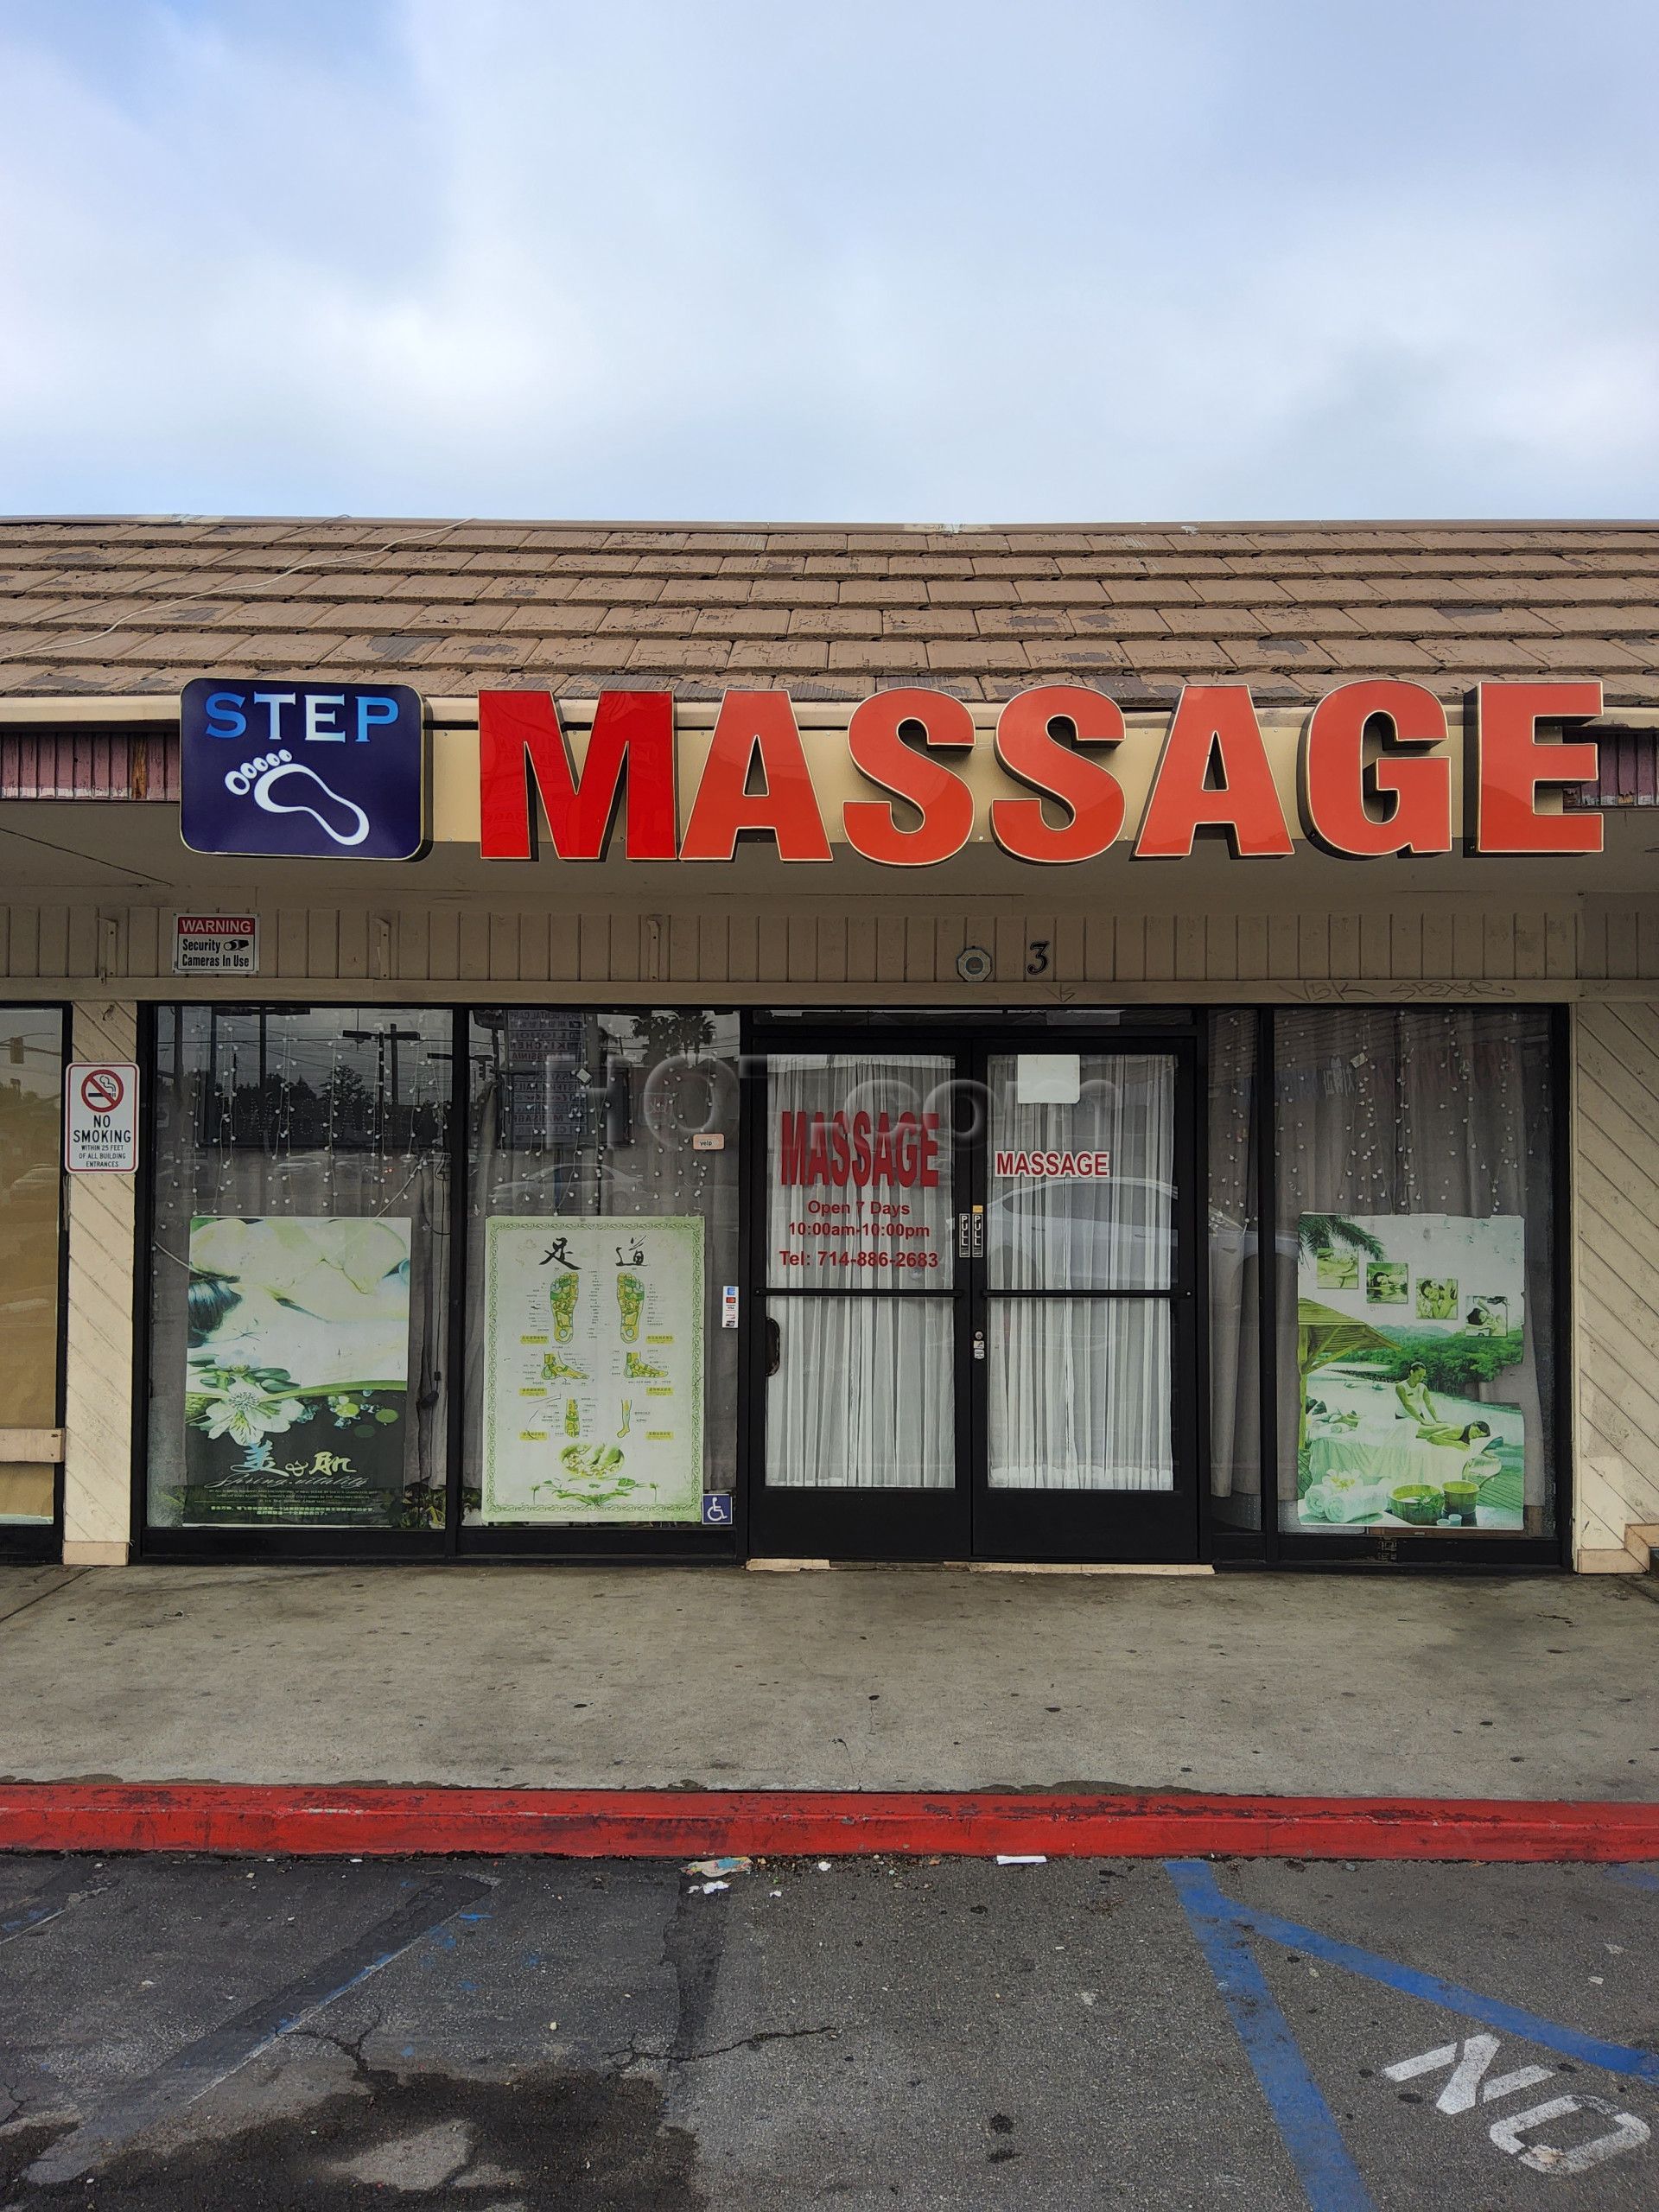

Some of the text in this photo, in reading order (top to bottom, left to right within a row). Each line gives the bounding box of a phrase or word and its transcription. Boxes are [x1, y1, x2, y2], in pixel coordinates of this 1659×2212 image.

[205, 691, 399, 743] STEP
[478, 680, 1605, 866] MASSAGE
[181, 919, 251, 933] WARNING
[182, 938, 221, 954] Security
[182, 954, 250, 967] Cameras In Use
[1027, 941, 1050, 976] 3
[93, 1115, 111, 1128] NO
[73, 1129, 131, 1143] SMOKING
[780, 1110, 940, 1187] MASSAGE
[996, 1152, 1109, 1176] MASSAGE
[808, 1200, 910, 1217] Open 7 Days
[789, 1222, 930, 1239] 10:00am-10:00pm
[779, 1251, 938, 1268] Tel: 714-886-2683
[1382, 2033, 1651, 2175] NO
